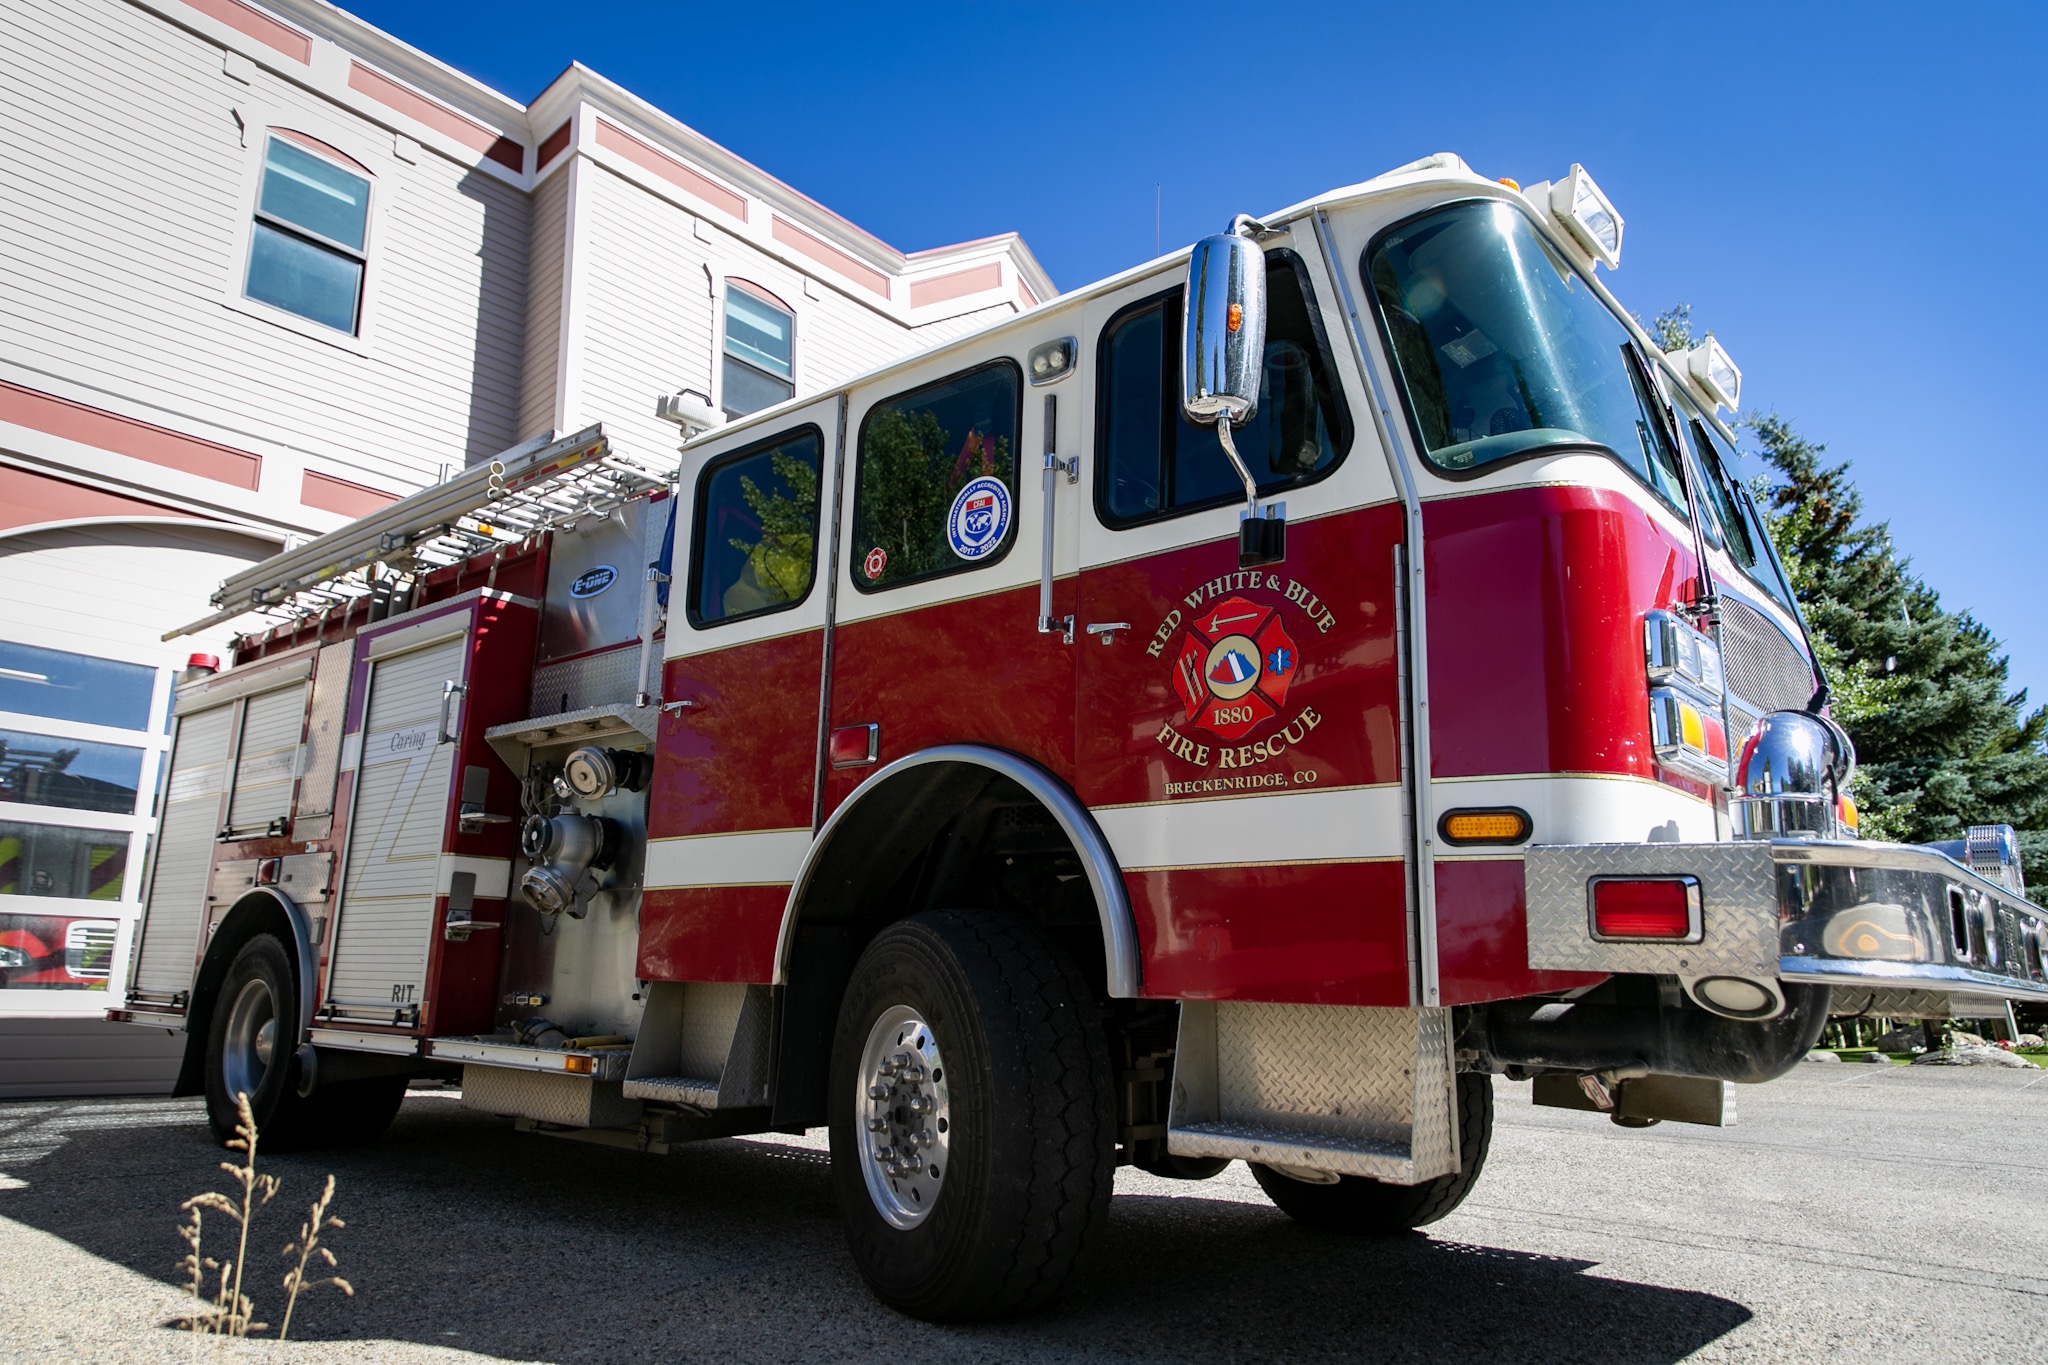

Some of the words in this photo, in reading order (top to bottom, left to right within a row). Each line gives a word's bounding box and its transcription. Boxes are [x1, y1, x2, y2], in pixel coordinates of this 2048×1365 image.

[973, 499, 986, 509] CFAI
[977, 482, 1004, 500] ACCREDITED
[1000, 500, 1008, 527] AGENCY
[959, 544, 976, 555] 2017
[980, 536, 997, 553] 2022
[573, 570, 611, 593] E-ONE
[1146, 609, 1182, 659] RED
[1184, 570, 1263, 609] WHITE
[1265, 574, 1281, 592] &
[1283, 578, 1336, 634] BLUE
[1213, 705, 1254, 727] 1880
[391, 729, 426, 752] Caring
[1155, 722, 1210, 767] FIRE
[1218, 706, 1322, 770] RESCUE
[1164, 773, 1289, 796] BRECKENRIDGE,
[1293, 770, 1318, 785] CO
[391, 984, 415, 1003] RIT
